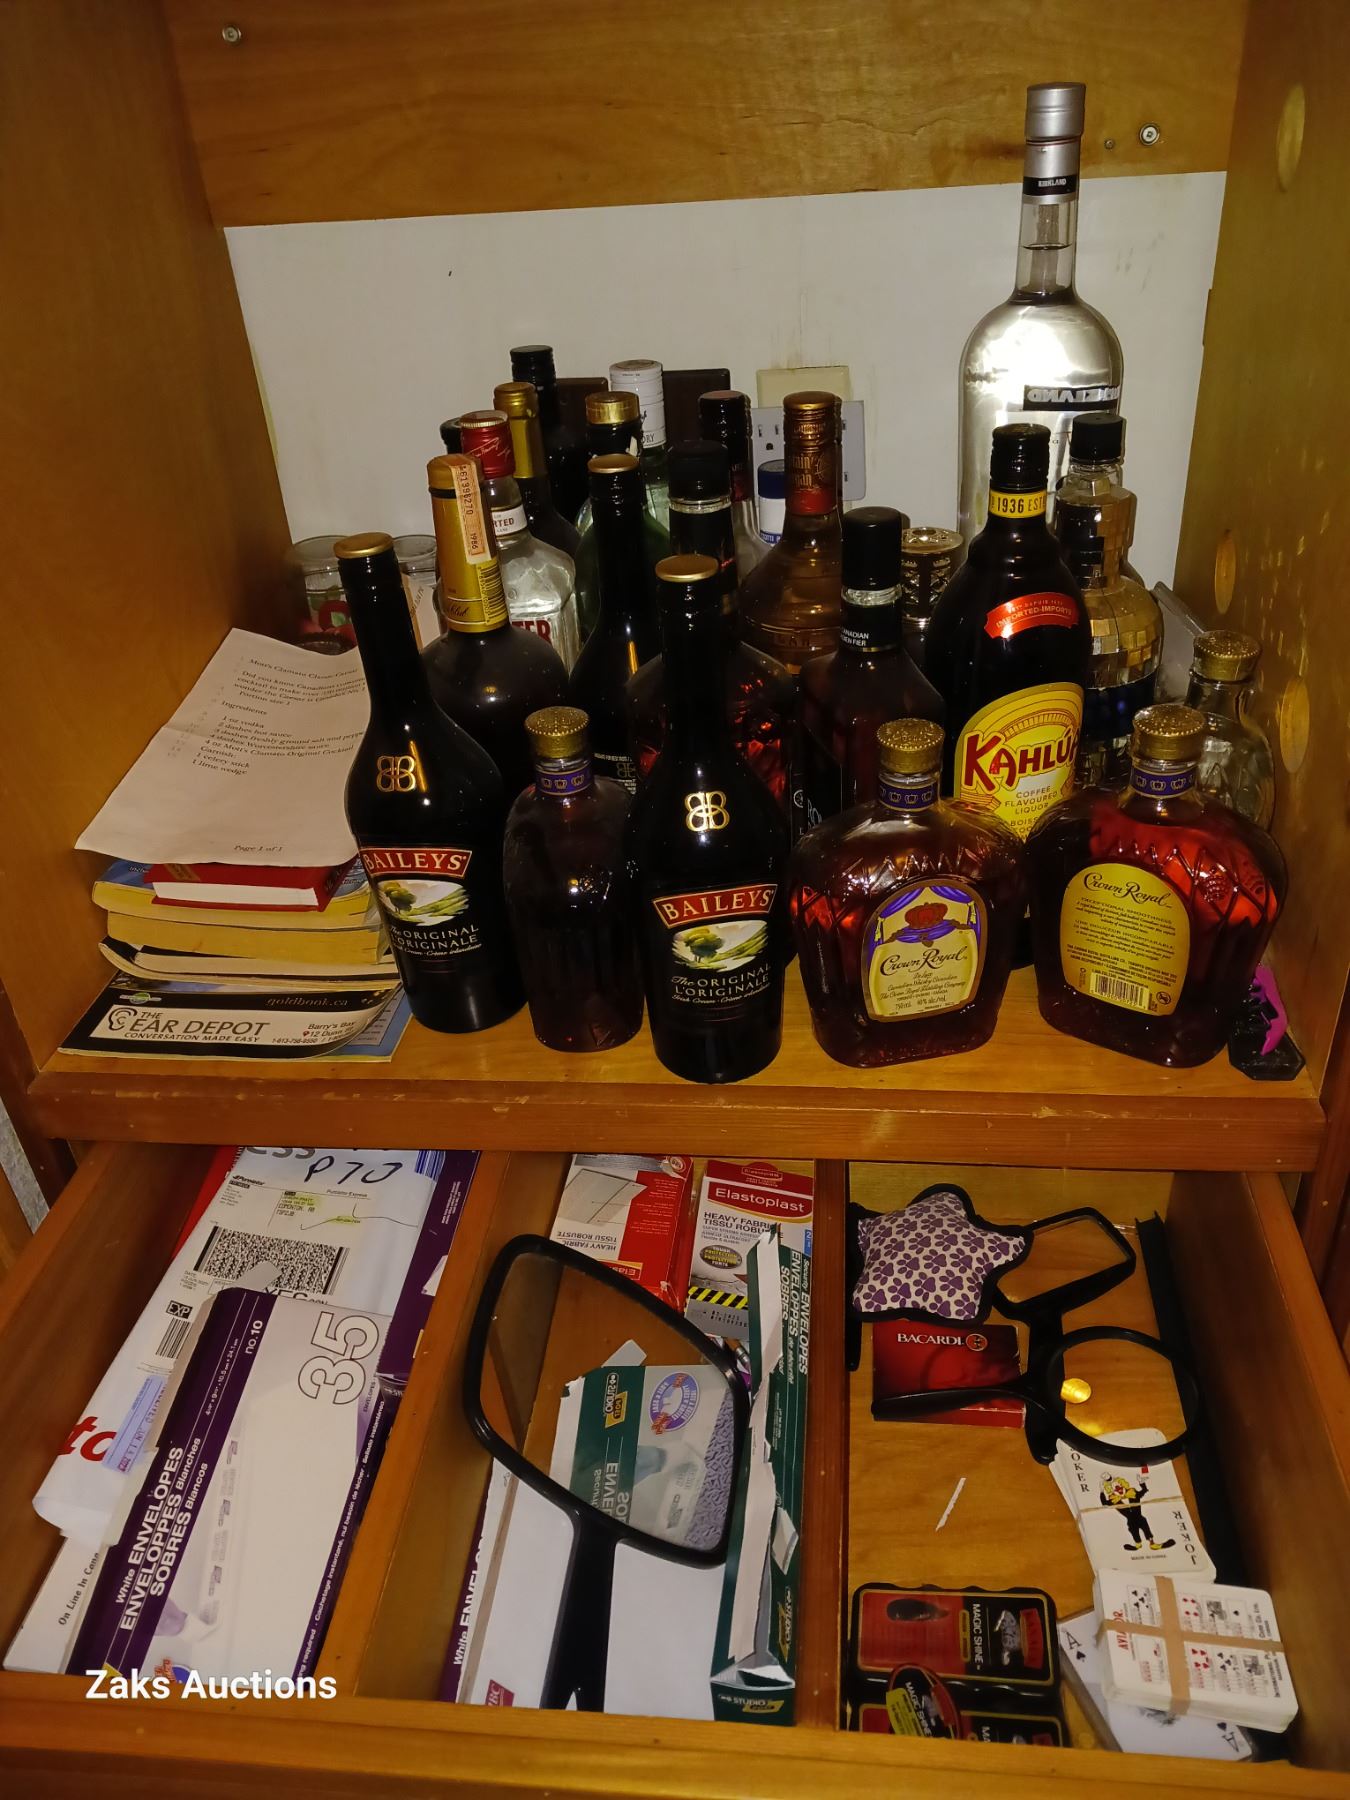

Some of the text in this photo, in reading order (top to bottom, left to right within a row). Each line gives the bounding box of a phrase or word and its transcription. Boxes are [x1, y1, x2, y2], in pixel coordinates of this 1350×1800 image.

[997, 498, 1025, 514] 1936
[493, 518, 515, 528] RTED
[1005, 791, 1058, 808] FLAVOURED
[1016, 785, 1051, 799] COFFEE
[1015, 802, 1049, 815] LIQUOR
[363, 853, 463, 871] BAILEYS
[1084, 872, 1171, 904] Crown Royal
[662, 889, 773, 920] BAILEYS
[403, 924, 479, 940] ORIGINAL
[880, 946, 967, 976] Crown Royal
[672, 963, 771, 987] The ORIGINAL
[675, 973, 770, 997] L'ORIGINALE
[130, 1019, 271, 1036] EAR DEPOT
[141, 1012, 163, 1020] THE
[124, 1032, 200, 1041] CONVERSATION
[201, 1034, 232, 1042] MADE
[715, 1188, 804, 1213] Elastoplast
[704, 1212, 771, 1230] HEAVY FABRI
[704, 1218, 733, 1228] TISSU
[557, 1231, 593, 1240] ROBUSTE
[781, 1265, 790, 1321] SOBRES
[790, 1250, 800, 1338] ENVELOPPES
[168, 1303, 190, 1318] EXP
[799, 1258, 810, 1375] Security ENVELOPES
[897, 1332, 963, 1346] BACARDI
[298, 1310, 381, 1406] 35
[1070, 1452, 1090, 1493] OKER
[114, 1568, 136, 1605] White
[127, 1446, 184, 1570] ENVELOPES
[120, 1436, 202, 1632] ENVELOPPES Blanches
[150, 1462, 209, 1598] SOBRES Blancos
[1172, 1510, 1197, 1566] JOKER
[58, 1610, 70, 1626] On
[66, 1585, 81, 1610] Line
[78, 1572, 88, 1588] In
[302, 1628, 317, 1664] required
[971, 1602, 983, 1666] MAGIC SHINE
[1064, 1631, 1082, 1650] A
[453, 1630, 468, 1666] White
[734, 1696, 766, 1706] STUDIO
[904, 1682, 922, 1712] MAGIC
[1222, 1732, 1240, 1753] A
